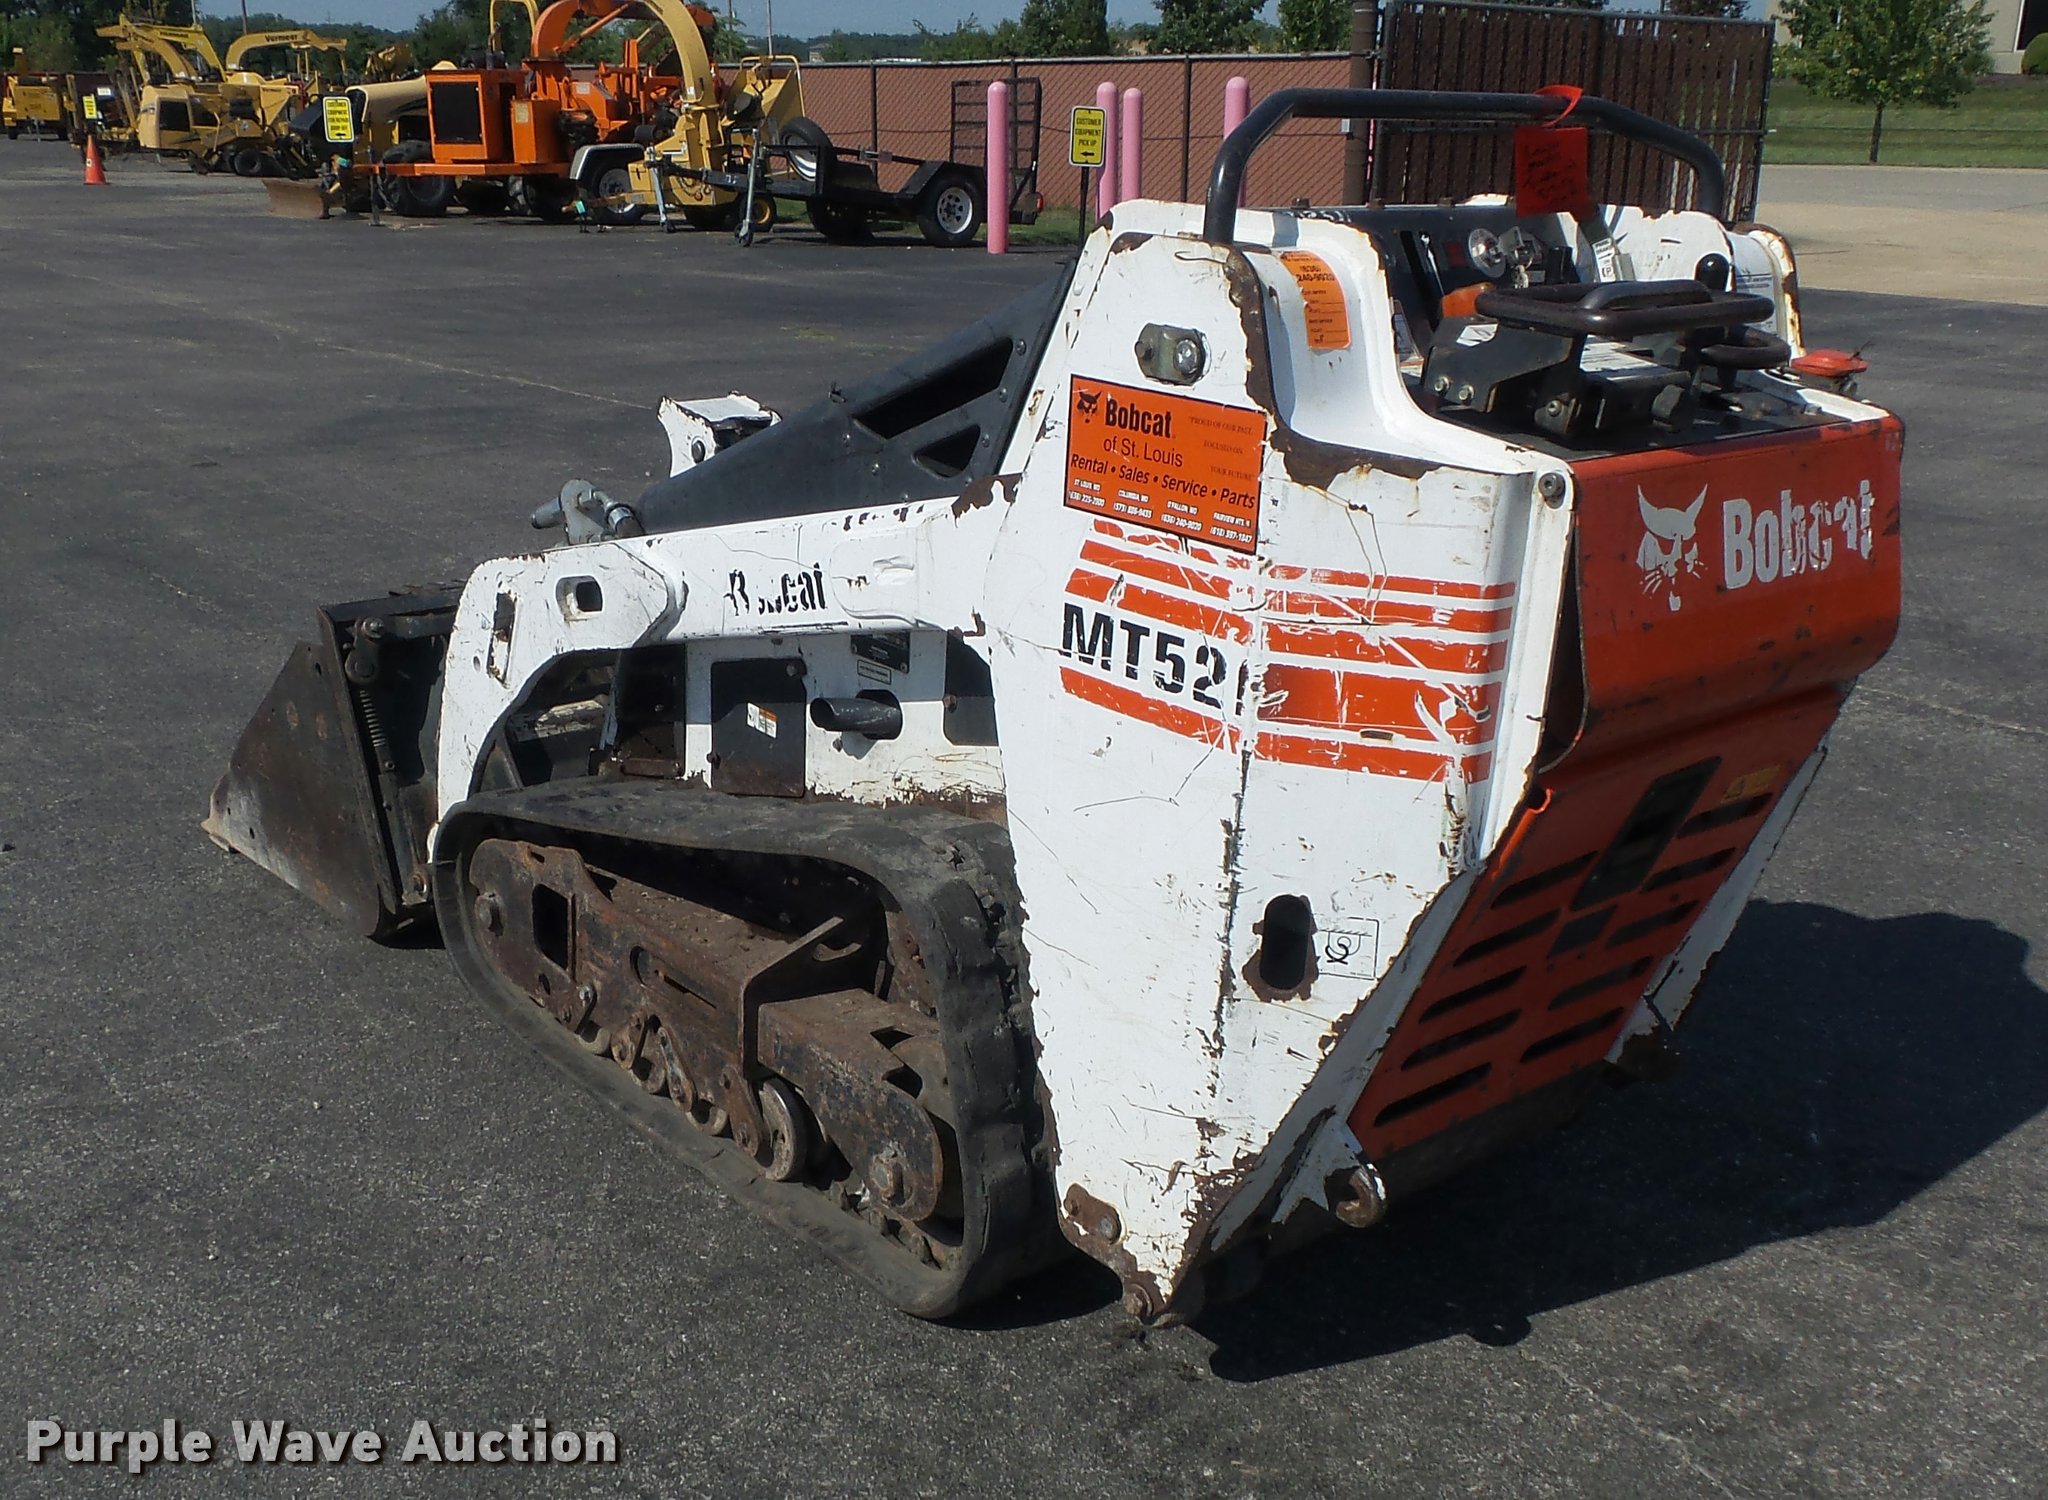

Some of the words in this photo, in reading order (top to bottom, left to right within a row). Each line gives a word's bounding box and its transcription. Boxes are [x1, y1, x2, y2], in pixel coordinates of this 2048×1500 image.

[1076, 118, 1102, 126] CUSTOMER
[1075, 128, 1102, 137] EQUIPMENT
[1090, 139, 1097, 147] UP
[1105, 397, 1172, 438] Bobcat
[1103, 436, 1117, 453] of
[1121, 438, 1139, 458] St.
[1144, 442, 1183, 468] Louis
[1070, 453, 1107, 475] Rental
[1119, 464, 1150, 484] Sales
[1161, 474, 1208, 498] Service
[1220, 488, 1256, 509] Parts
